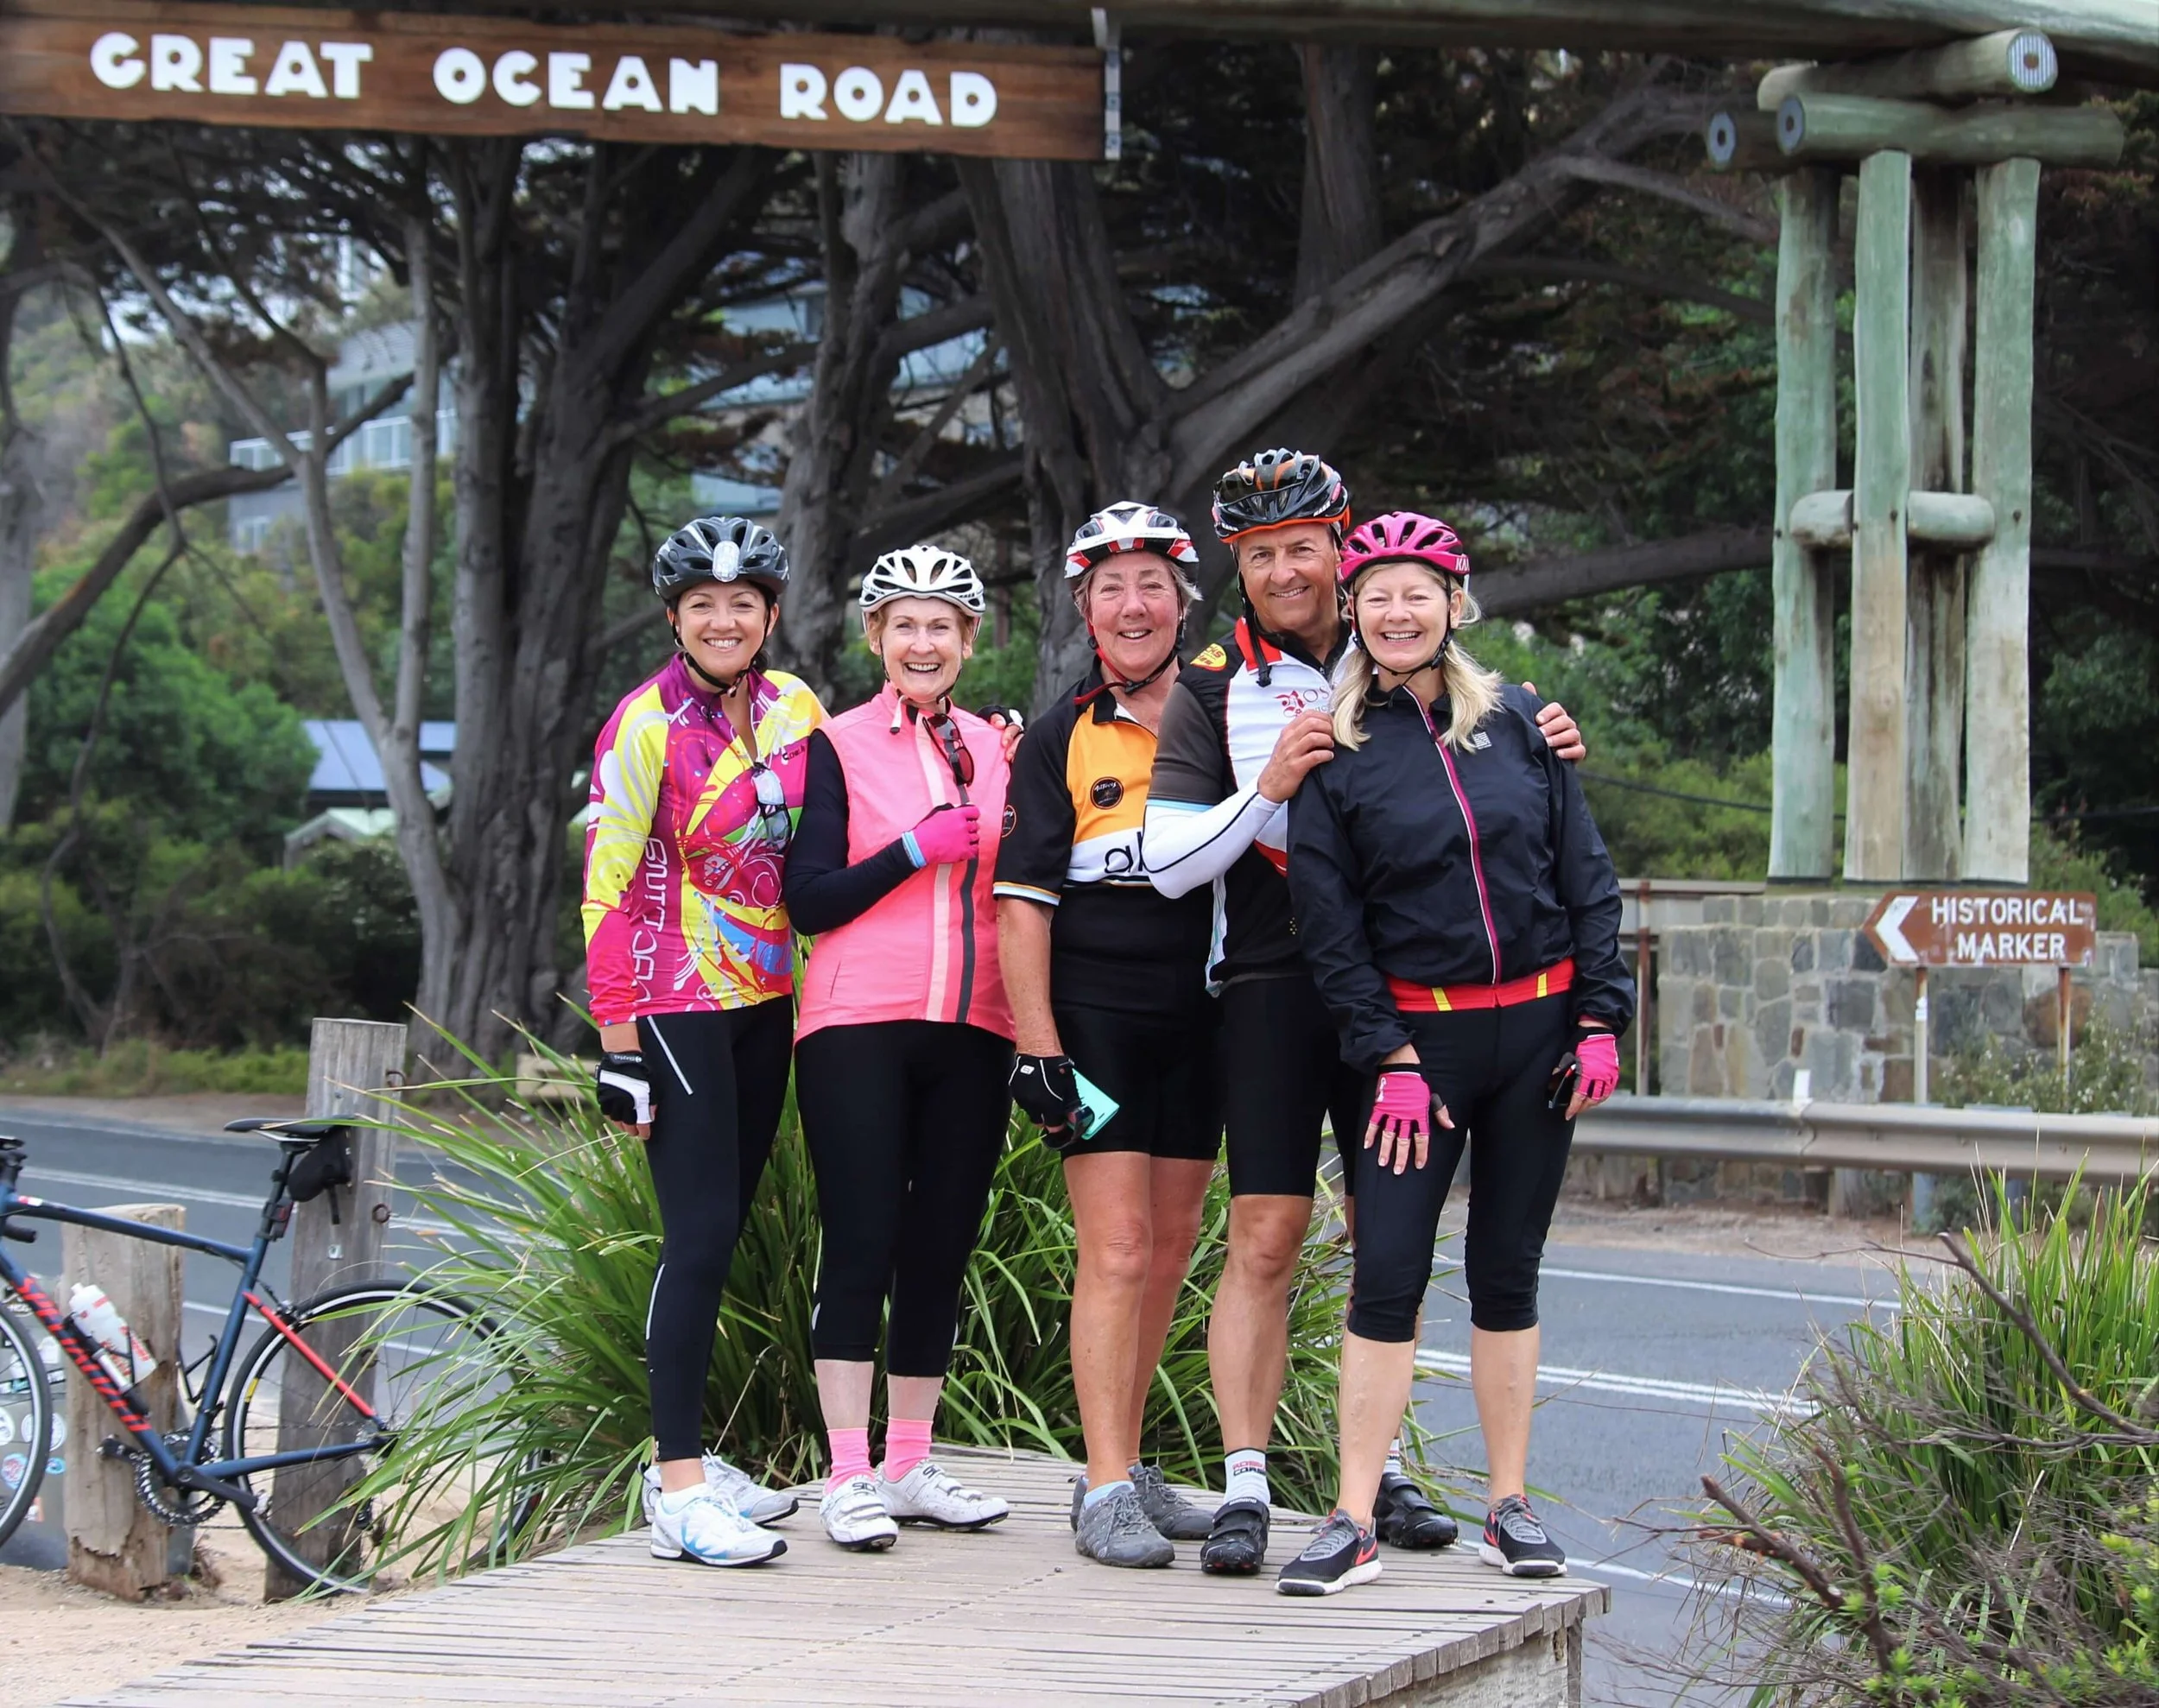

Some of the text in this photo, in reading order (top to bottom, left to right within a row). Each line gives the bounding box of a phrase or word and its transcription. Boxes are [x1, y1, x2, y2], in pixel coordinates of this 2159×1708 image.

[90, 32, 997, 128] GREAT OCEAN ROAD
[1931, 896, 2084, 926] HISTORICAL
[1955, 932, 2067, 960] MARKER
